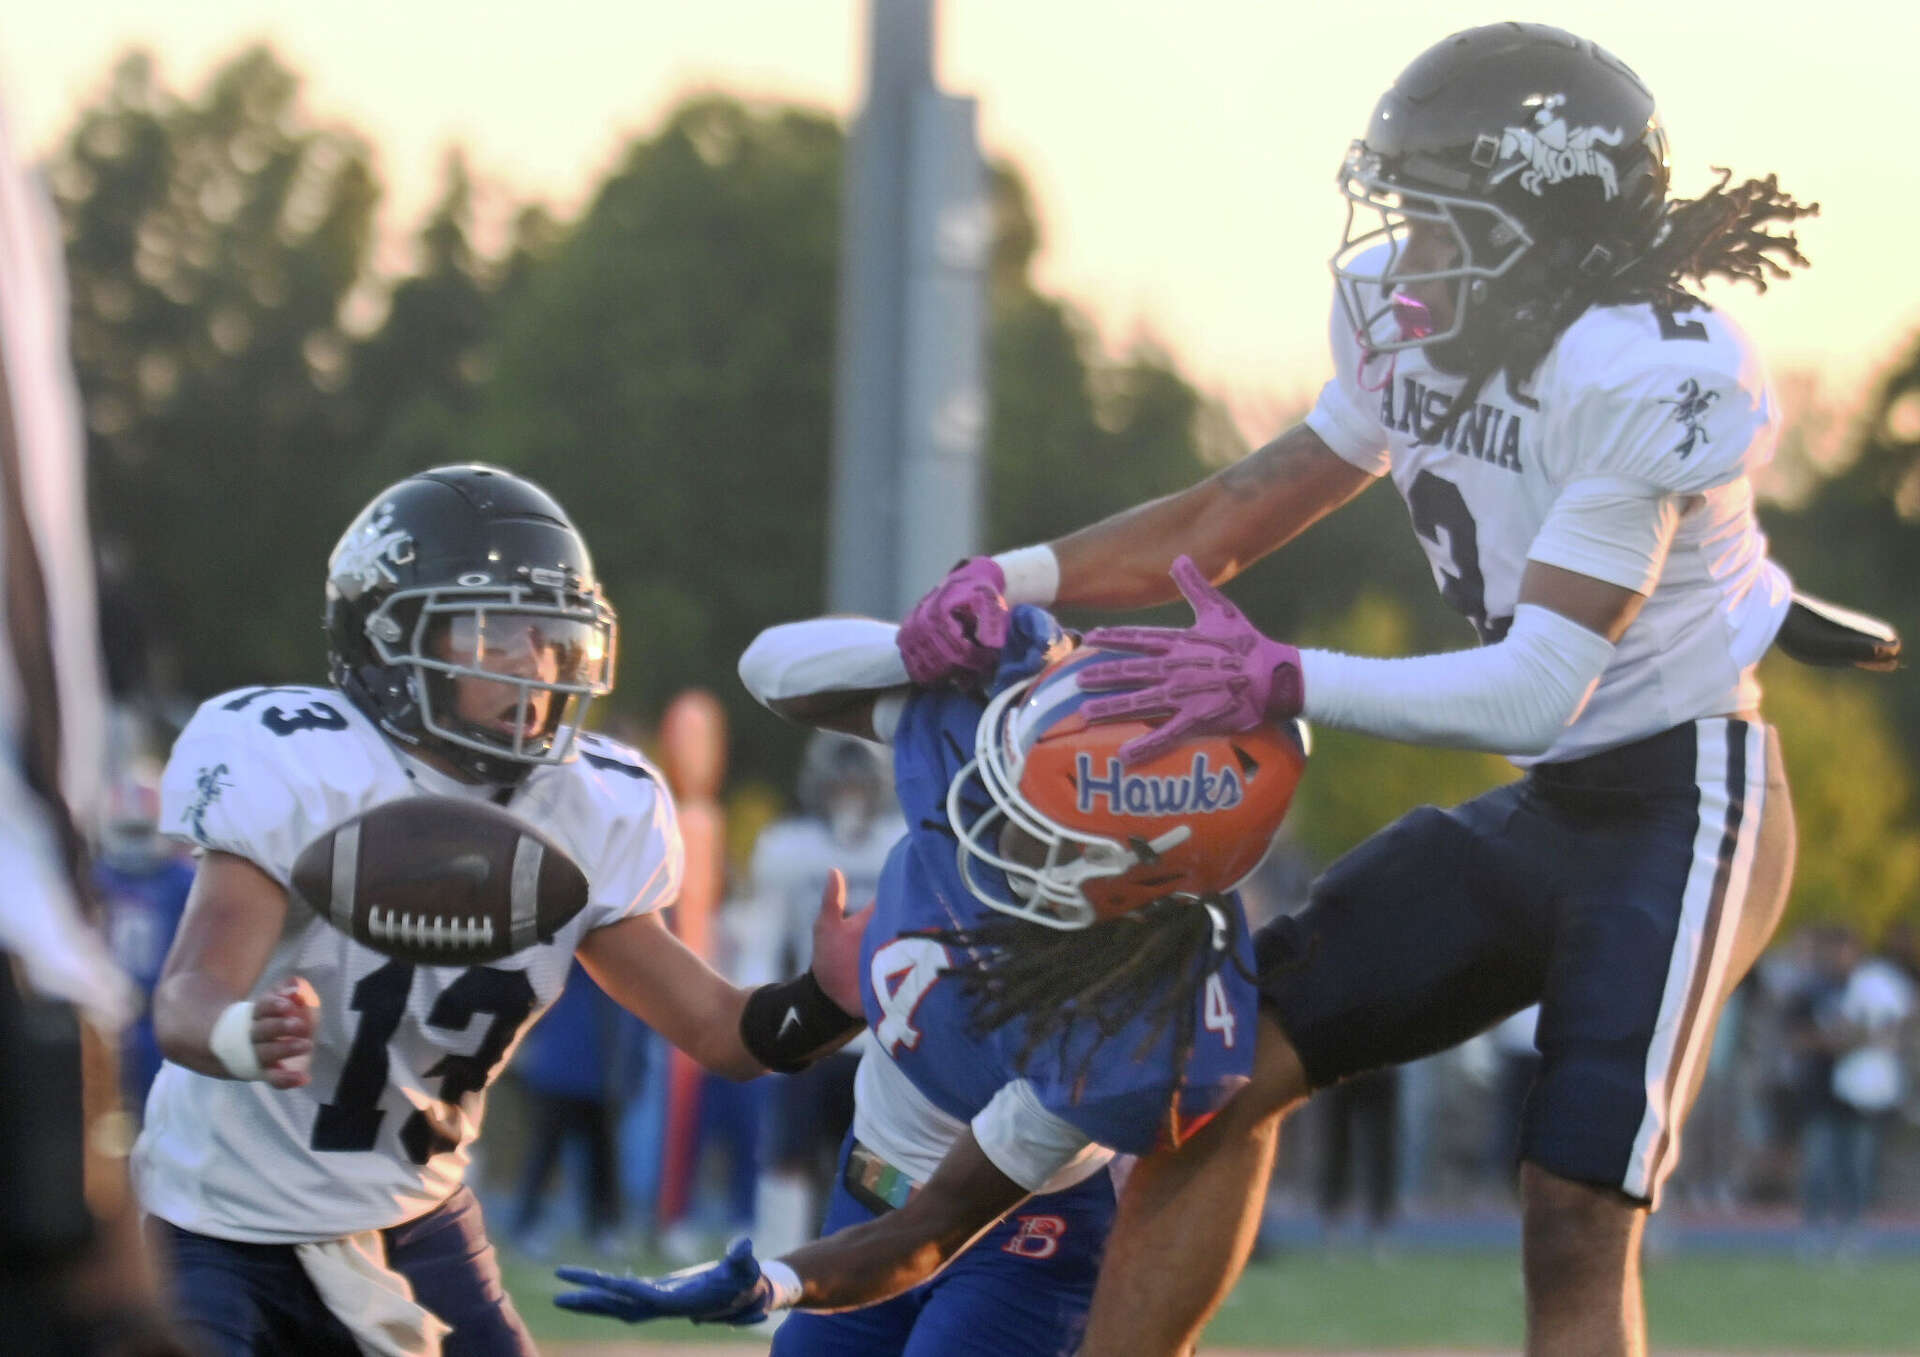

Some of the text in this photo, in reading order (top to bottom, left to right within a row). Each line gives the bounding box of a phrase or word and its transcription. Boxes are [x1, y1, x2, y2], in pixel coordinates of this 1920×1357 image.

[1075, 752, 1243, 817] Hawks
[1204, 968, 1236, 1049] 4
[310, 956, 538, 1166] 13
[1003, 1214, 1067, 1259] B
